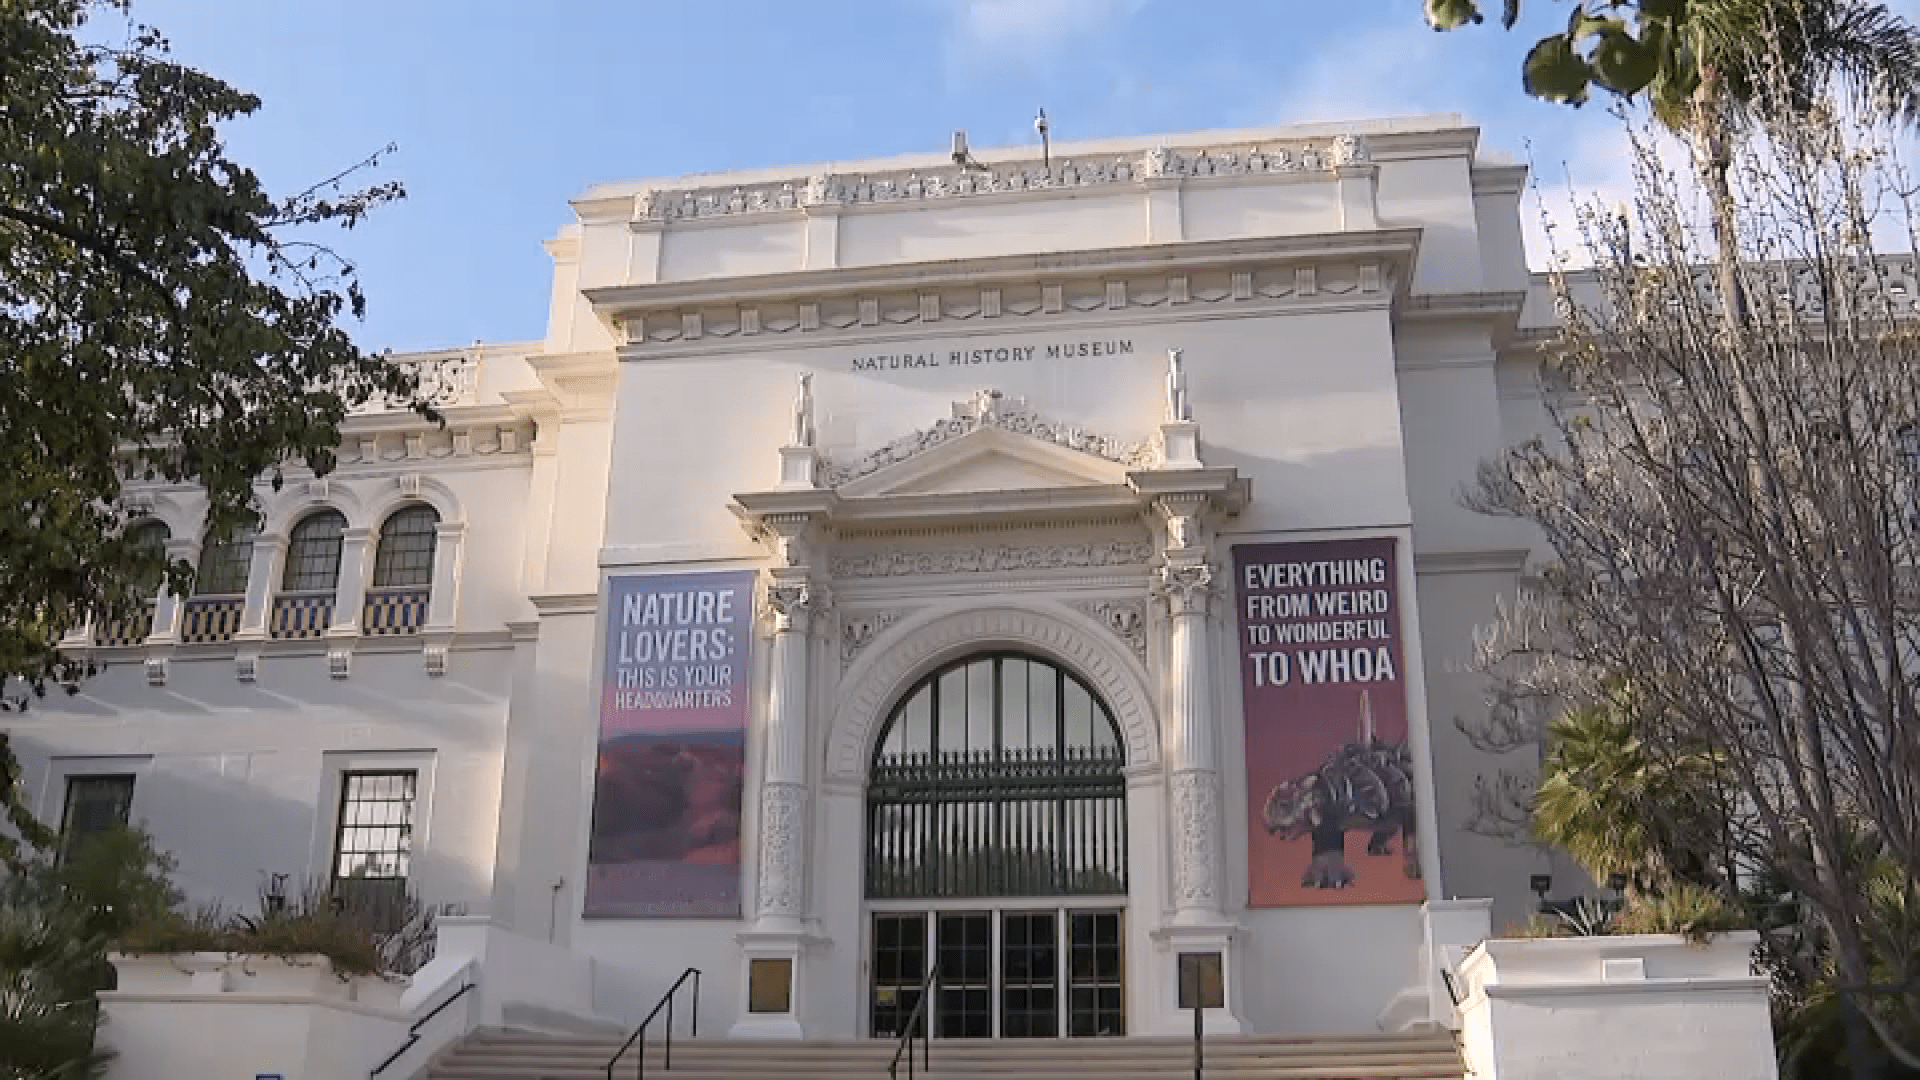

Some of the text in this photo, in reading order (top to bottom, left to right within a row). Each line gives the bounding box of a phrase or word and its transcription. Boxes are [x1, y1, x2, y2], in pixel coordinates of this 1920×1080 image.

[853, 340, 1134, 371] NATURAL HISTORY MUSEUM
[1245, 558, 1385, 589] EVERYTHING
[623, 590, 734, 626] NATURE
[1247, 589, 1388, 619] FROM WEIRD
[619, 628, 734, 663] LOVERS:
[1248, 618, 1392, 644] TO WONDERFUL
[617, 665, 732, 688] THIS IS YOUR
[1248, 647, 1396, 687] TO WHOA
[616, 690, 732, 711] HEADQUARTERS
